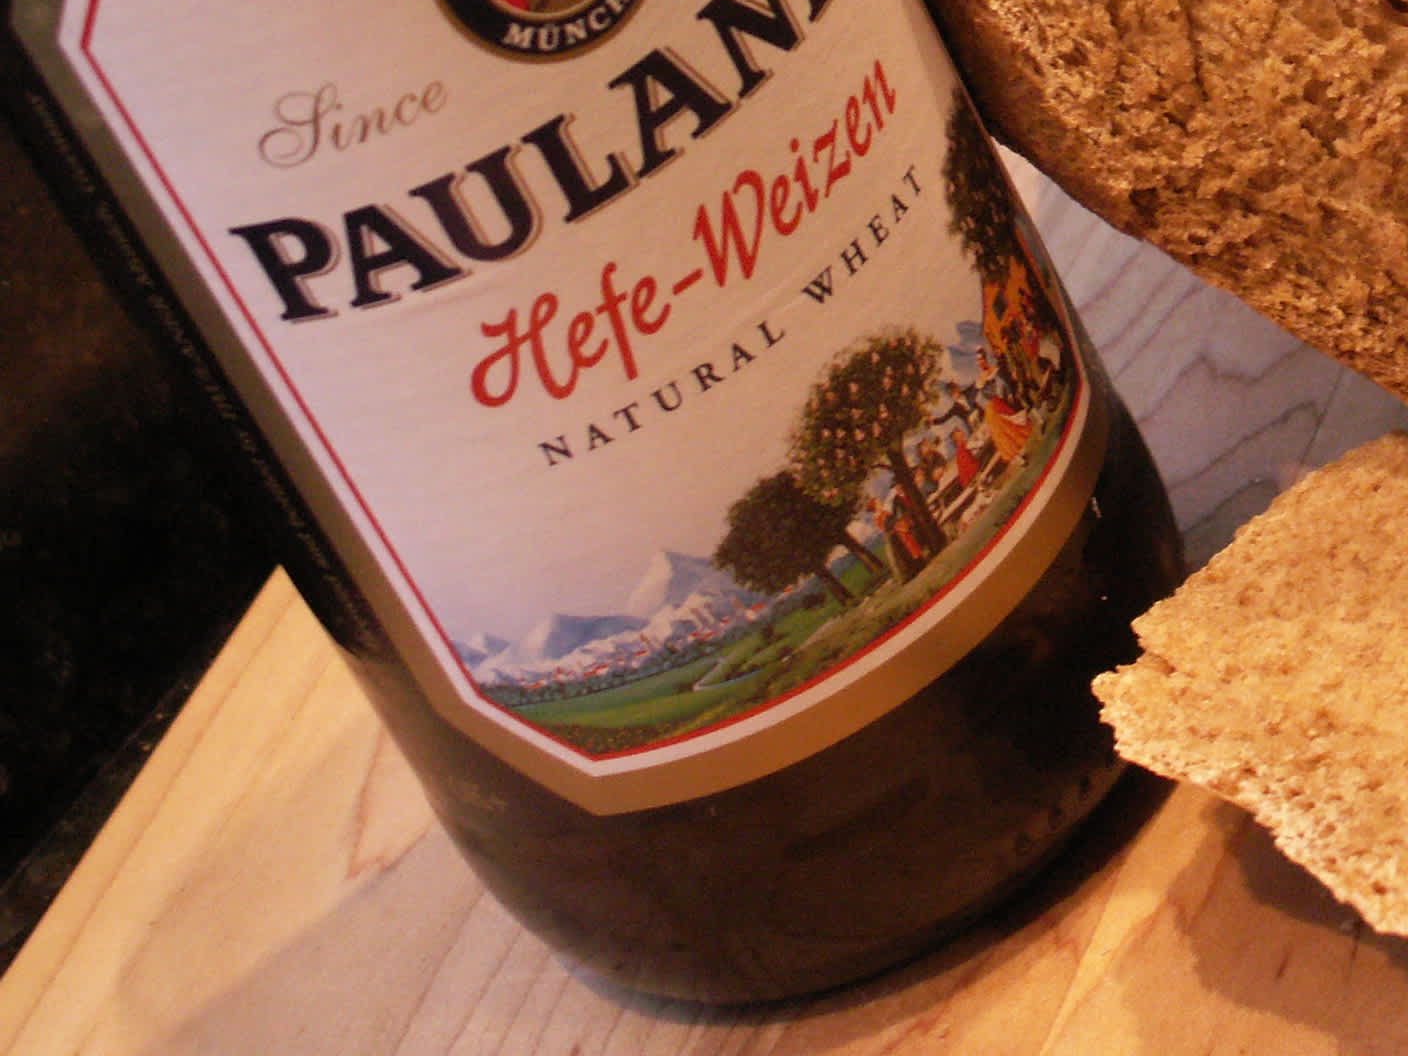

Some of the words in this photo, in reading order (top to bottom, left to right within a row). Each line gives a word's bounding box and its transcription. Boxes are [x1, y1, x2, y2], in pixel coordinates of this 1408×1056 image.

[258, 80, 448, 169] Since
[471, 60, 896, 407] Hefe-Weizen
[539, 322, 785, 466] NATURAL
[802, 166, 924, 305] WHEAT
